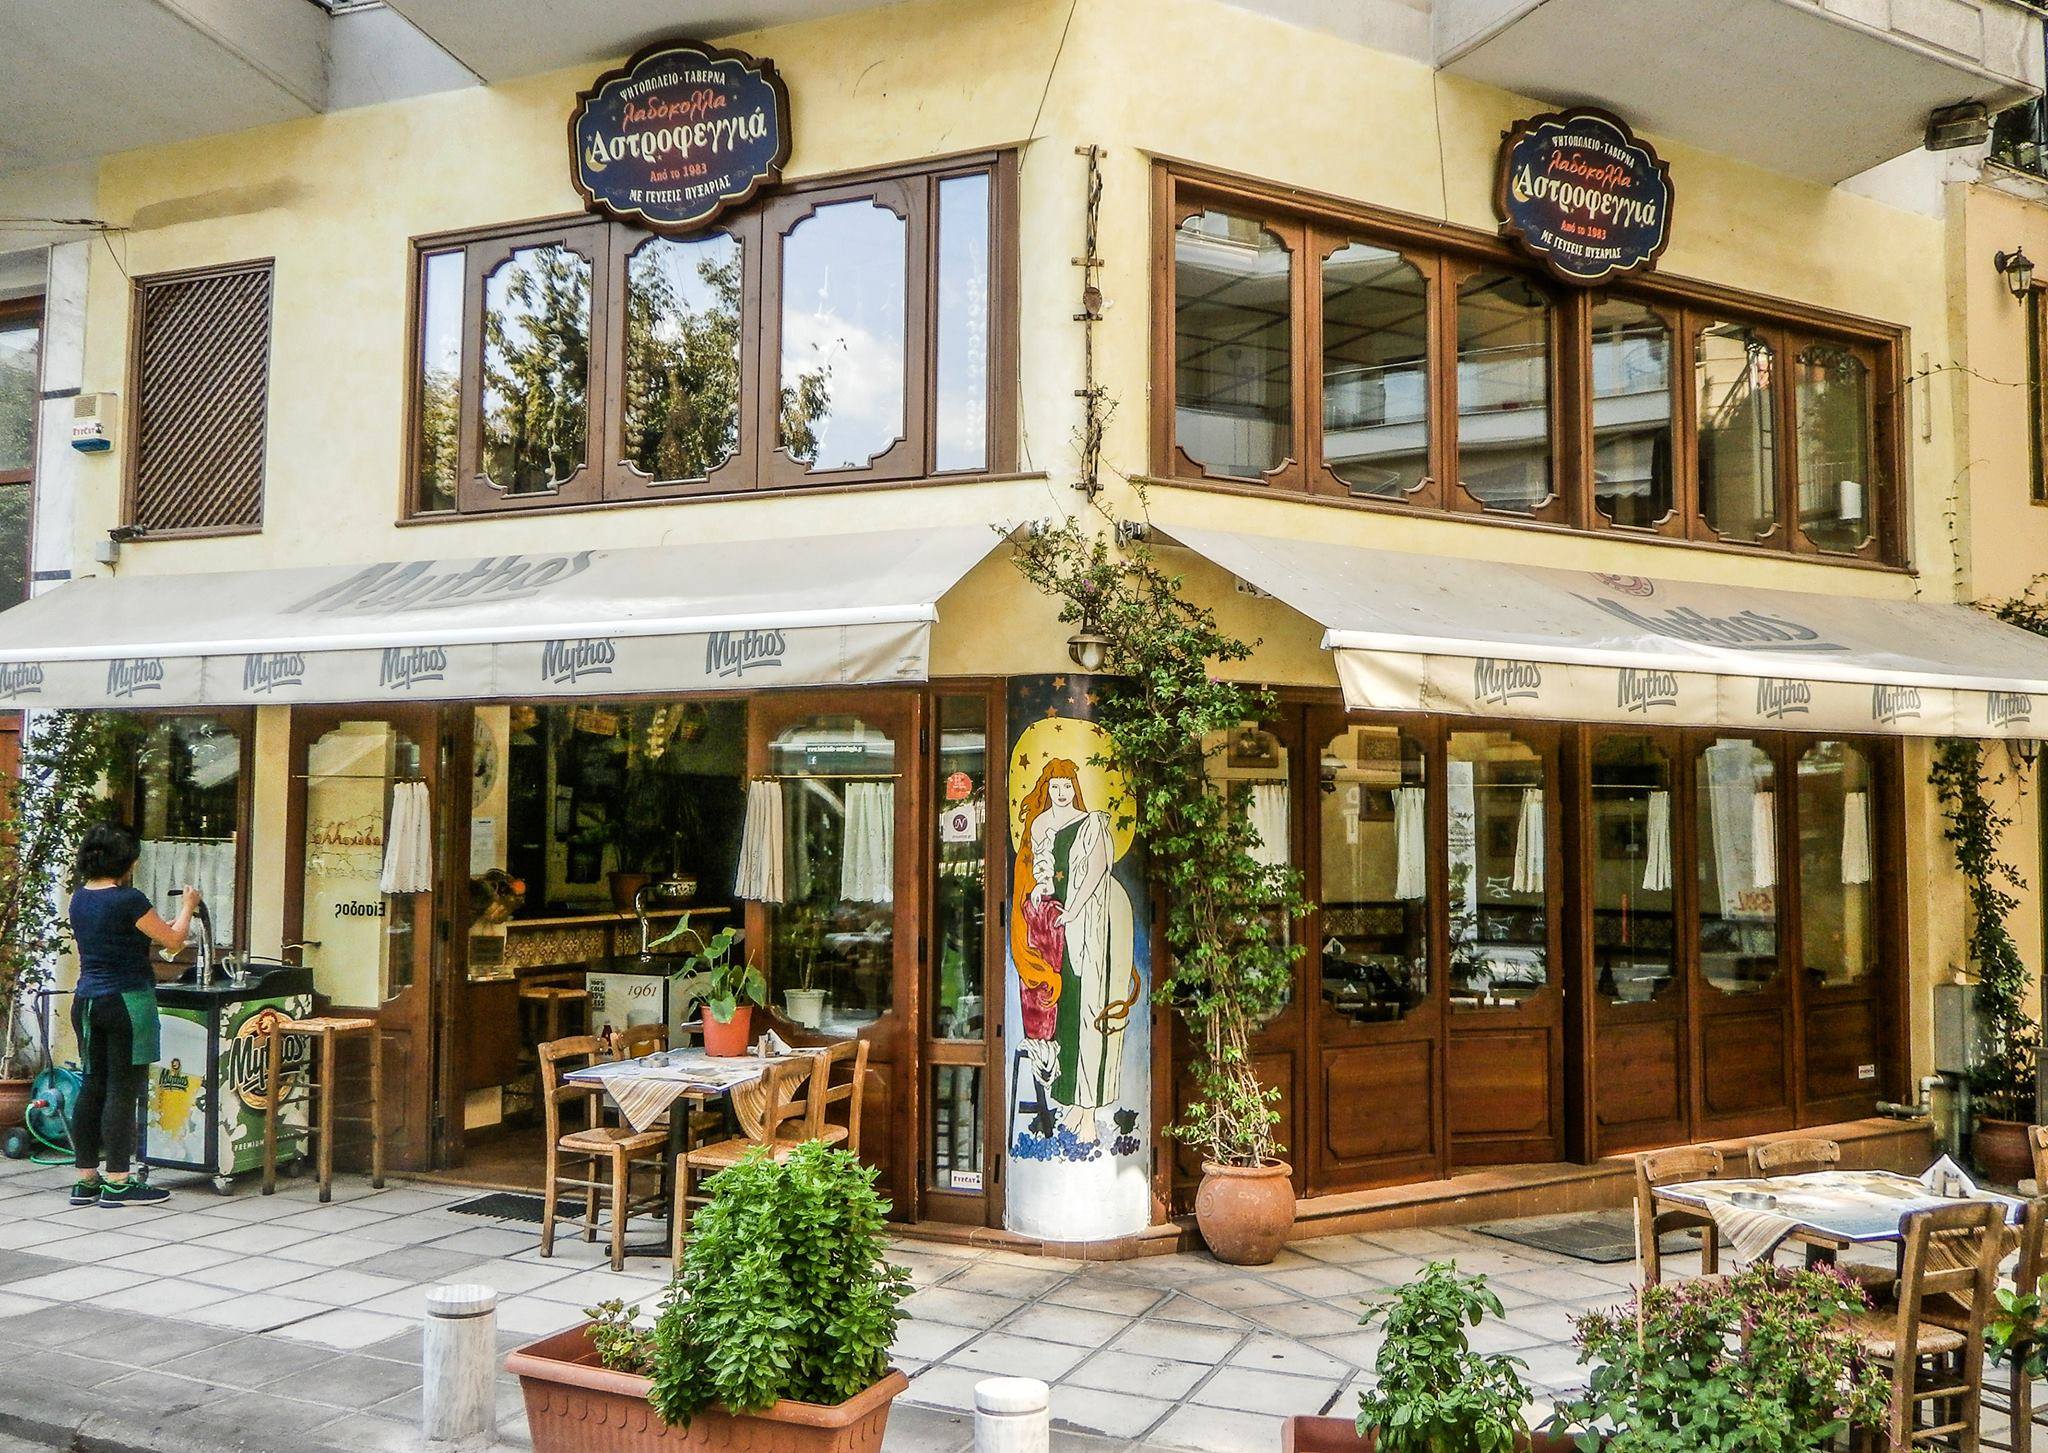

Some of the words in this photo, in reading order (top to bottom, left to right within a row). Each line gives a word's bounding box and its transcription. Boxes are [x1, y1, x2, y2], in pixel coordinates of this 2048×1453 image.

[684, 70, 727, 86] ΤΑΒΕΡΝΑ
[589, 106, 767, 163] Αστροφεγγιά
[1603, 142, 1635, 168] ΤΑΒΕΡΝΑ
[682, 163, 707, 178] 1983
[628, 187, 643, 203] ΜΕ
[645, 187, 682, 203] ΓΕΥΣΕΙΣ
[1516, 163, 1656, 228] Αστροφεγγιά
[1540, 229, 1553, 243] ΜΕ
[1553, 236, 1583, 256] ΓΕΥΣΕΙΣ
[278, 549, 597, 618] Mythos
[243, 652, 305, 693] Mythos
[379, 647, 447, 689] Mythos
[542, 638, 615, 683] Mythos
[705, 630, 786, 677] Mythos
[107, 658, 163, 697] Mythos
[1474, 657, 1541, 705] Mythos
[1618, 667, 1678, 713] Mythos
[1756, 676, 1811, 719] Mythos
[1872, 684, 1921, 724] Mythos
[1987, 691, 2032, 728] Mythos
[627, 982, 657, 999] 1961
